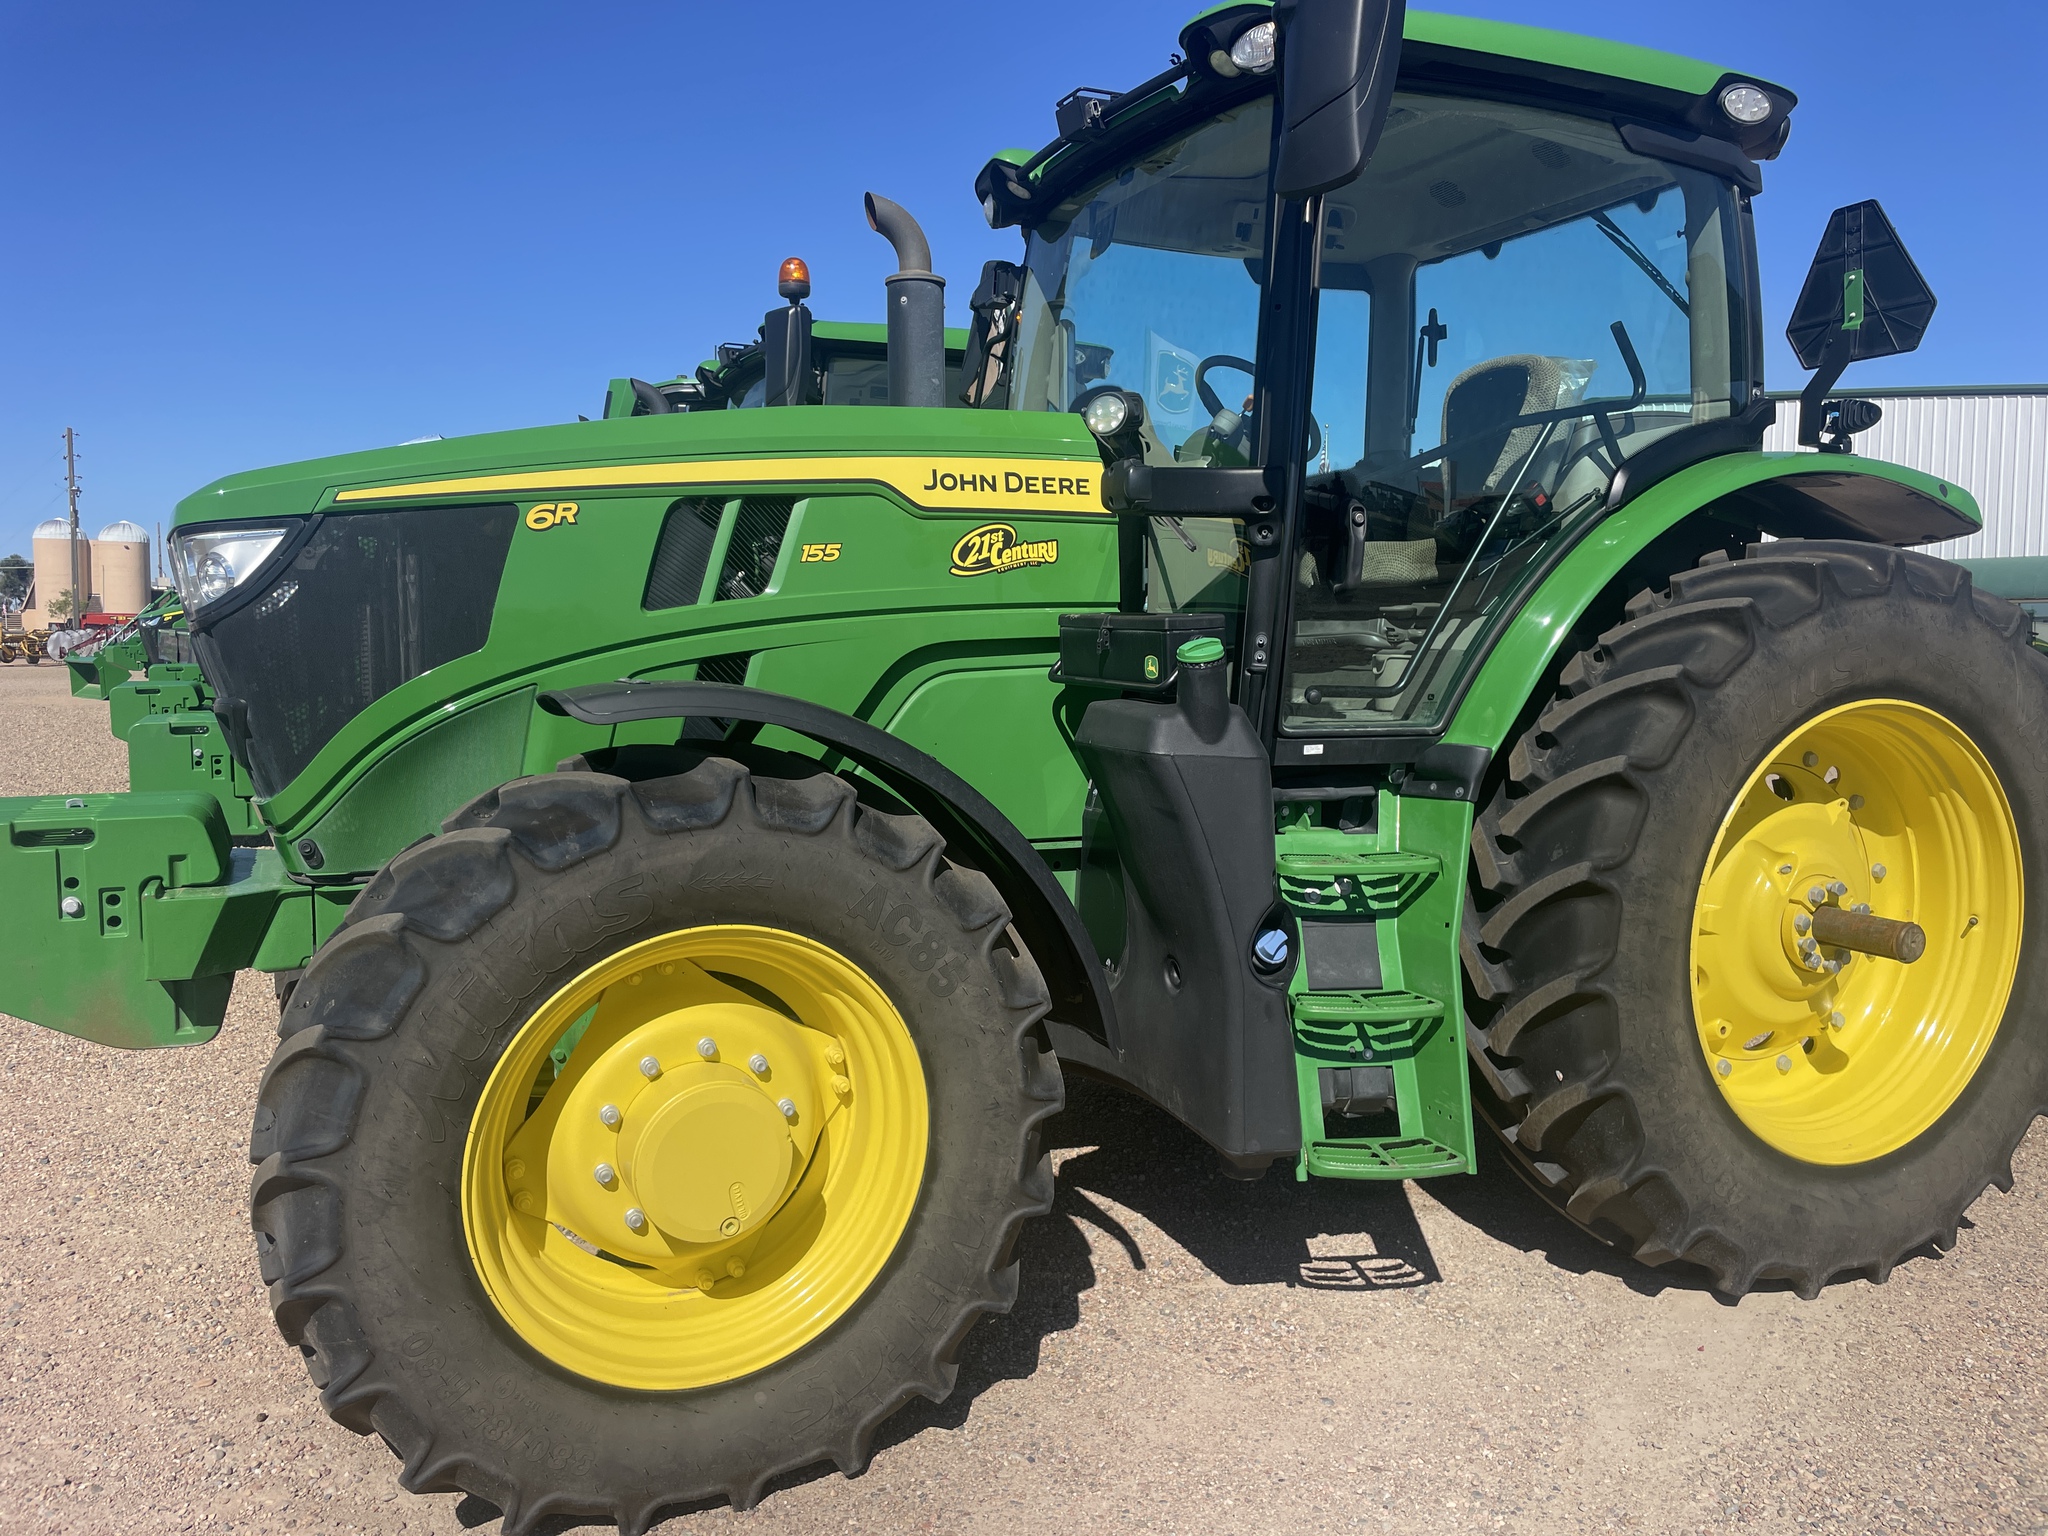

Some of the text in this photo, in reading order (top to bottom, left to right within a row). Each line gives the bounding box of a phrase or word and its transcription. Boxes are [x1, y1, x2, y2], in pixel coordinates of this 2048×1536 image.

[923, 468, 1091, 496] JOHN DEERE
[525, 502, 580, 532] 6R
[800, 543, 843, 563] 155
[963, 529, 1005, 568] 21st
[845, 882, 971, 998] AC85
